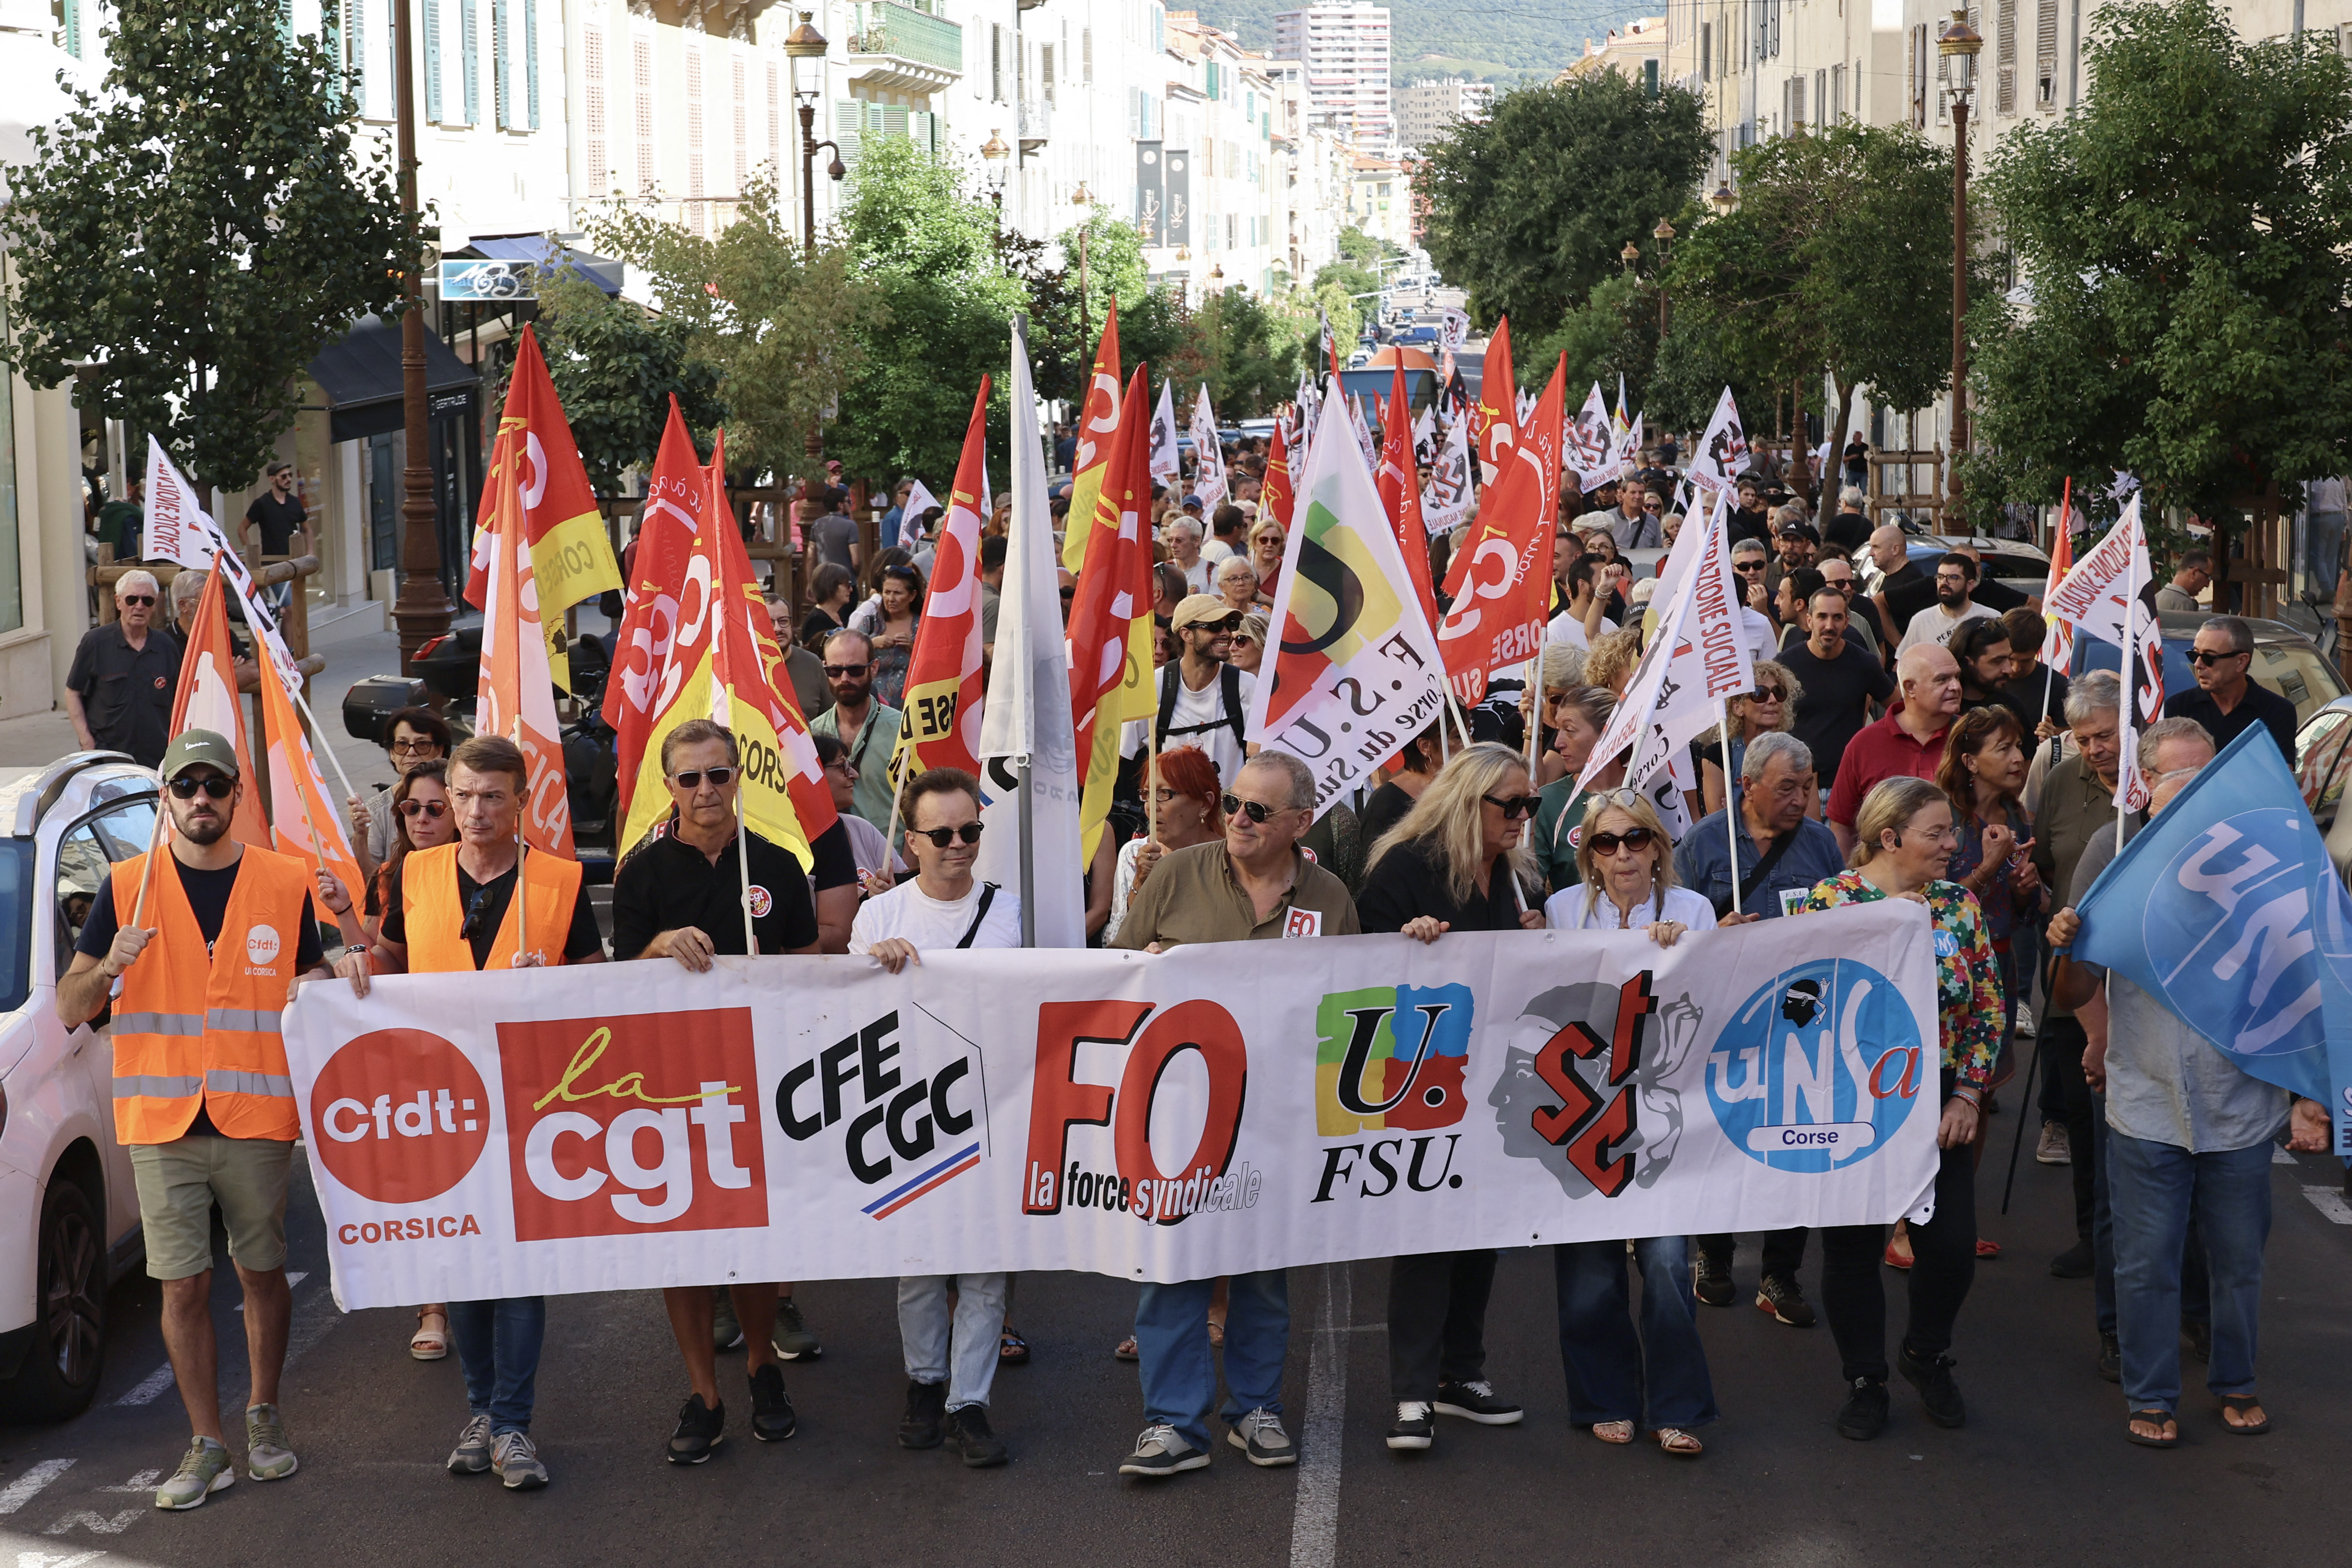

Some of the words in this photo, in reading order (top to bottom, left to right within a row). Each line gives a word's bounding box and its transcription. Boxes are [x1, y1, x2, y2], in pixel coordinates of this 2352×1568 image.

[436, 394, 467, 410] GERTRUDE
[1701, 622, 1742, 698] SUCIALE
[1286, 910, 1315, 937] FO
[252, 968, 277, 976] CORSICA
[533, 1026, 741, 1112] la
[775, 1008, 901, 1141] CFE
[845, 1056, 974, 1185] CGC
[1022, 999, 1247, 1226] FO
[1781, 1128, 1839, 1147] Corse
[525, 1081, 751, 1225] cgt
[1028, 1160, 1055, 1207] la
[1068, 1160, 1130, 1212] force
[1135, 1160, 1262, 1226] syndicale
[338, 1213, 481, 1246] CORSICA
